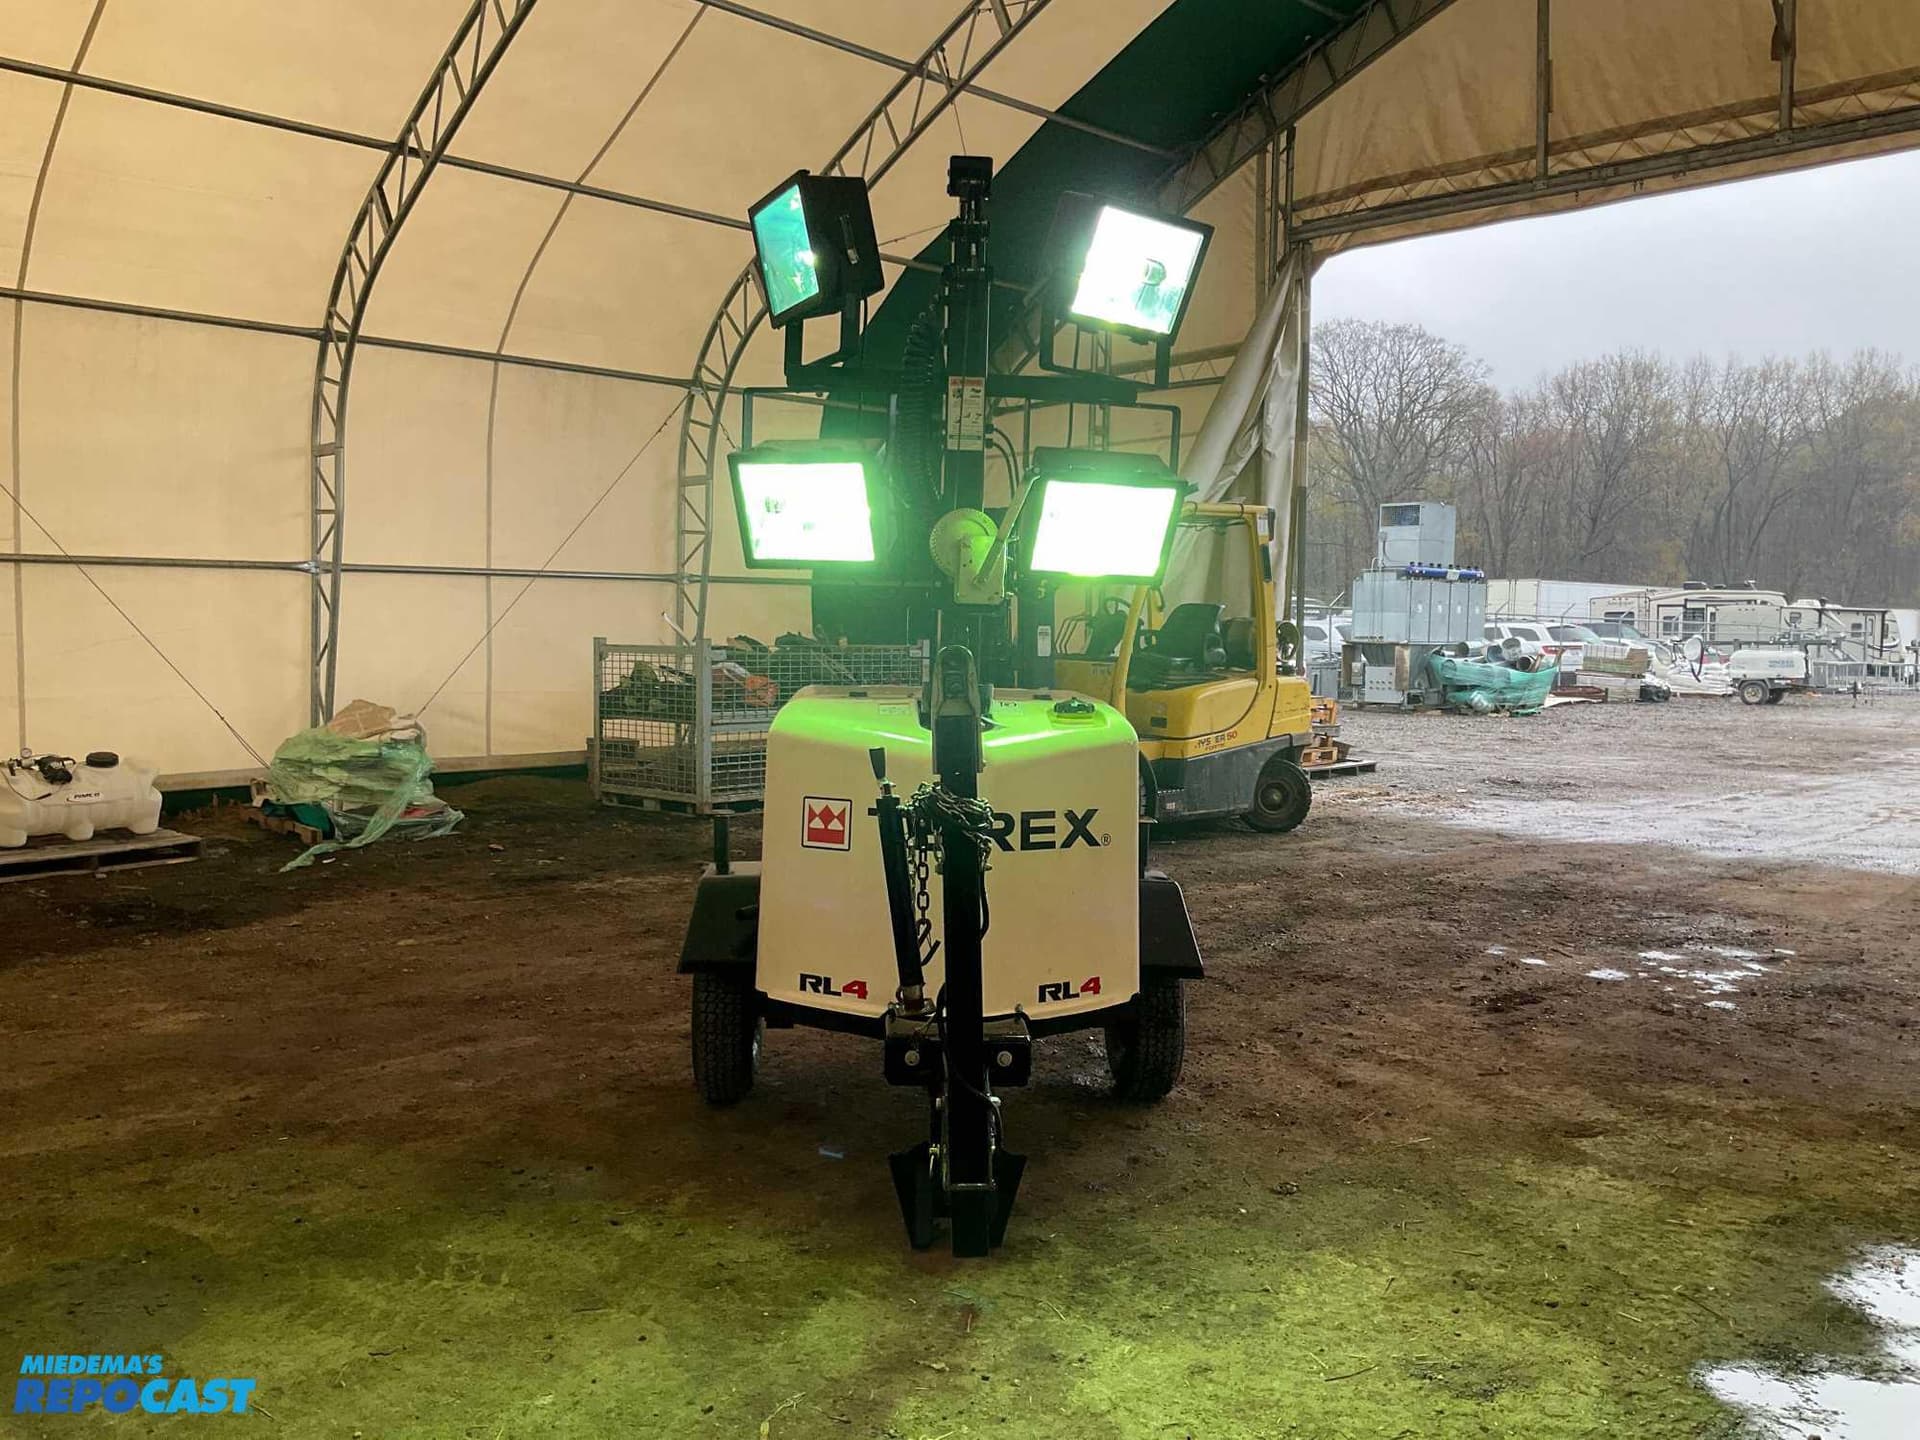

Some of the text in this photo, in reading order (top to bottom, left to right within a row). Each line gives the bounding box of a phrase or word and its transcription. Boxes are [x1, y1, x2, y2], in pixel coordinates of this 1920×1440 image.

[1226, 730, 1238, 741] 50
[799, 973, 869, 1000] RL4
[1038, 976, 1102, 1003] RL4
